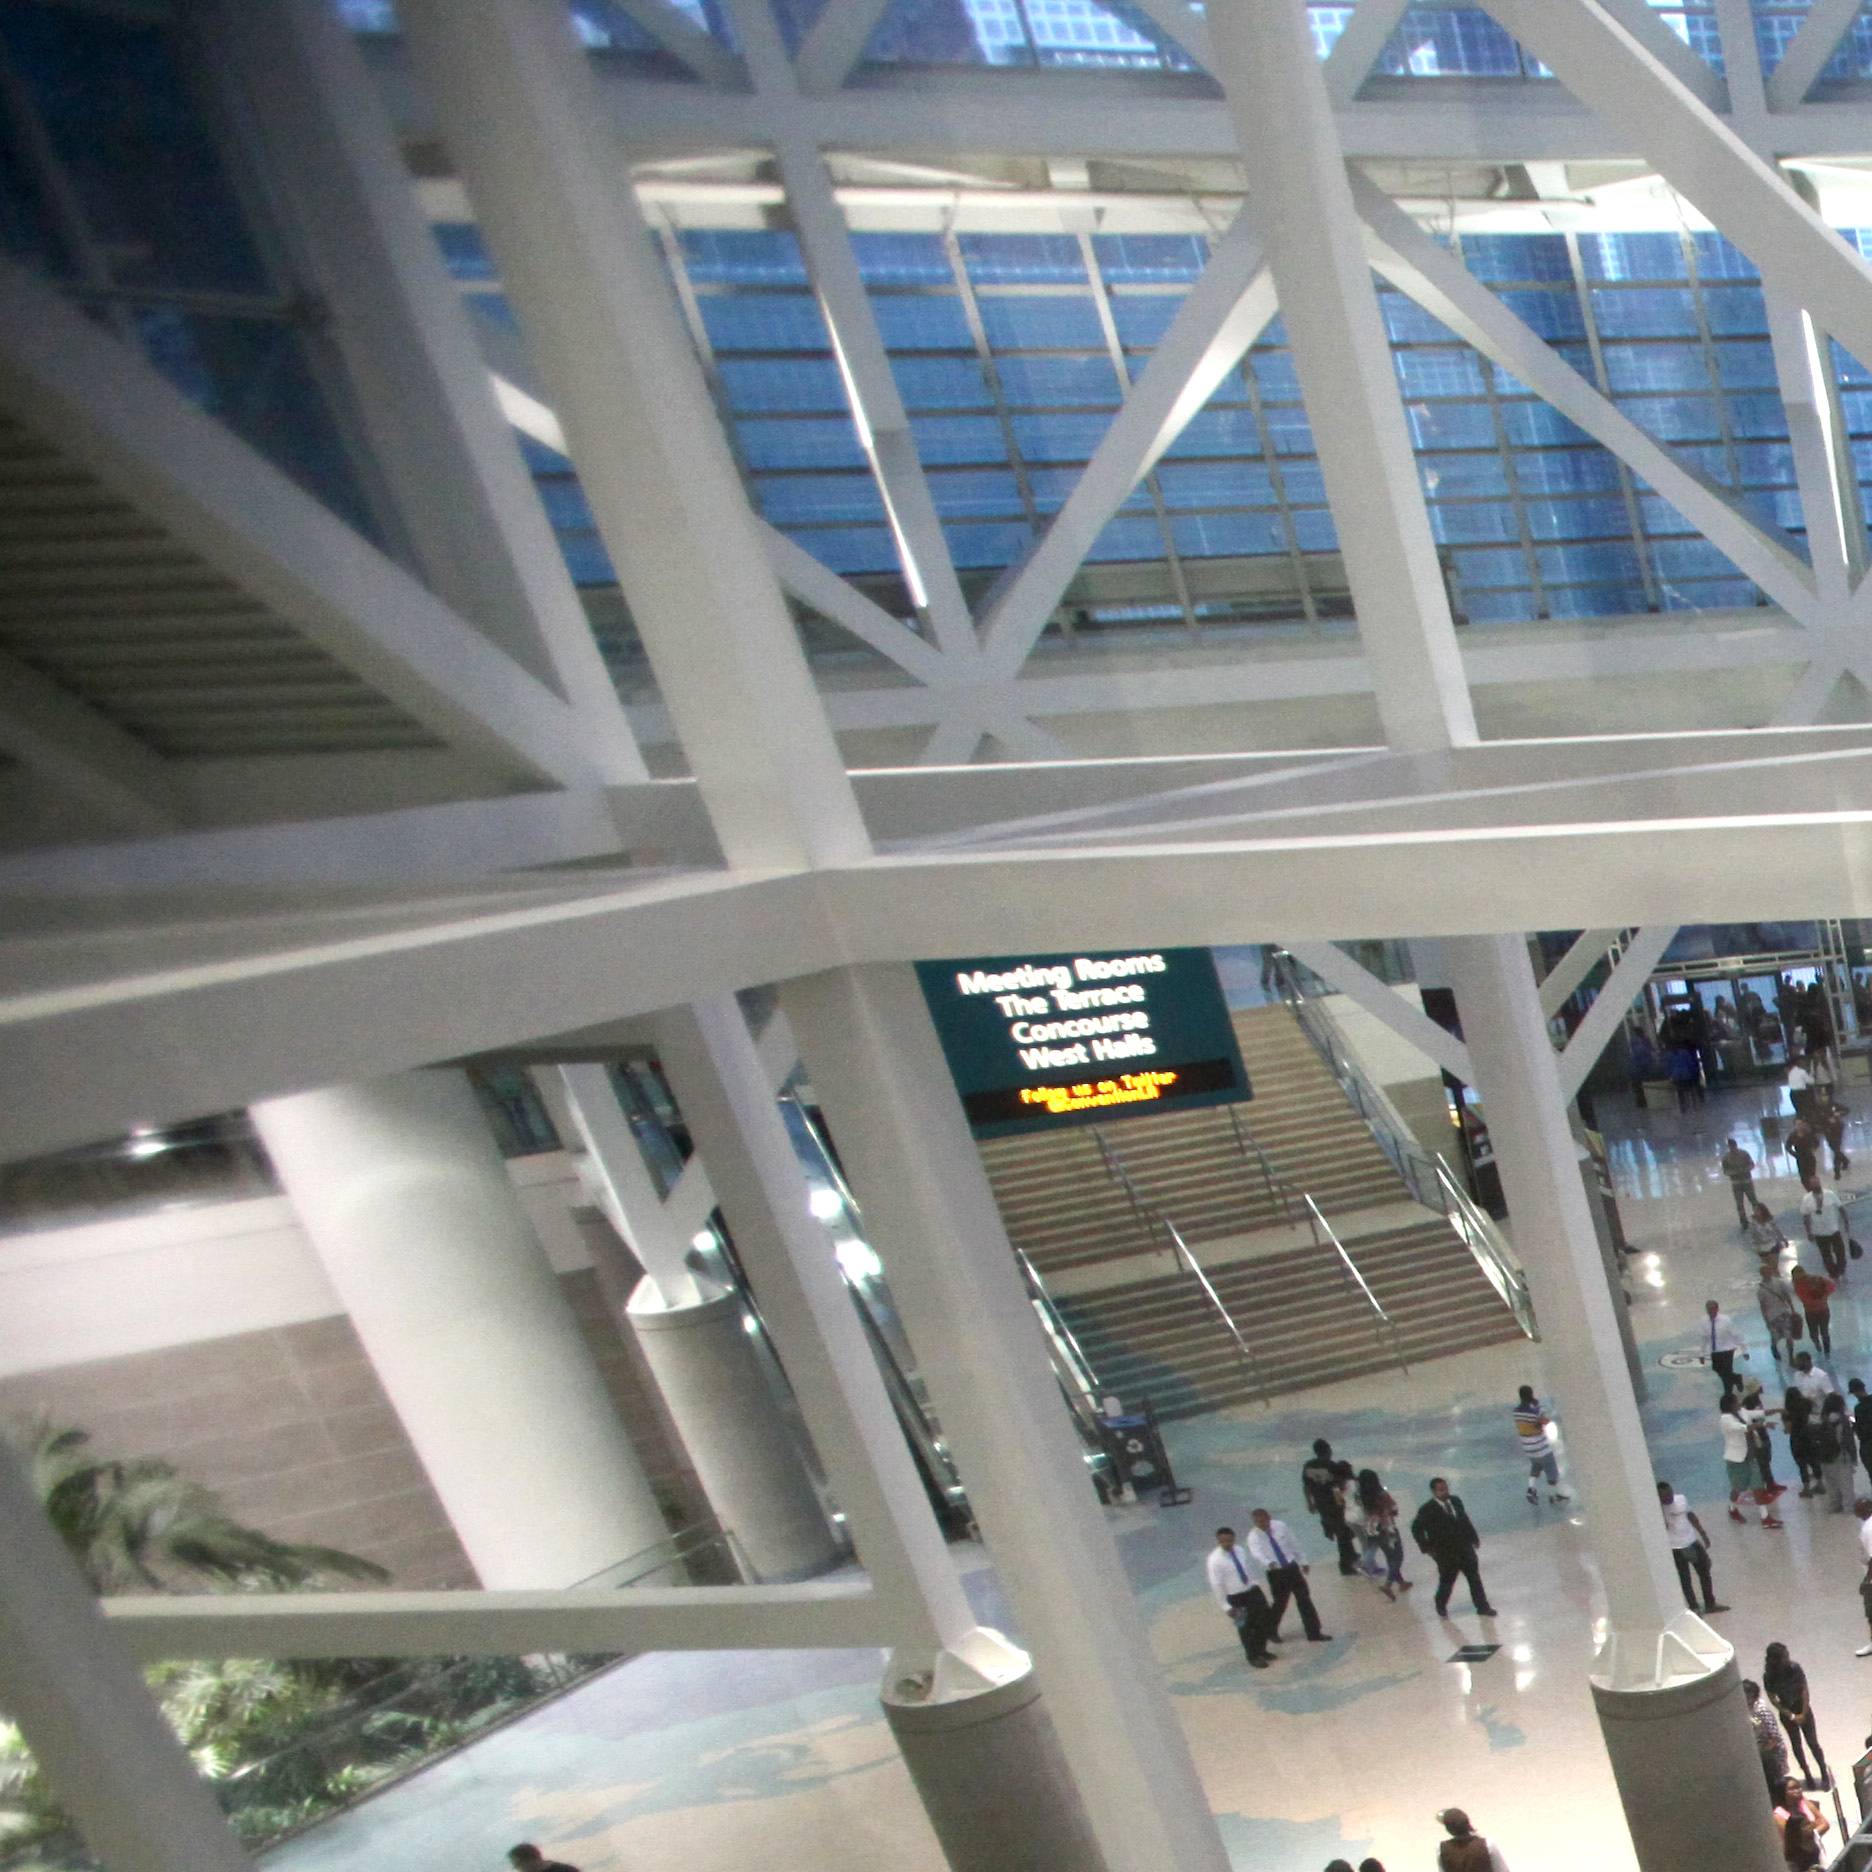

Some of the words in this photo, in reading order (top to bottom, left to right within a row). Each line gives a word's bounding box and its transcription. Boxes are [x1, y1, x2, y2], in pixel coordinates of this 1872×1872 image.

[957, 963, 1074, 994] Meeting
[1075, 953, 1166, 982] Rooms
[996, 996, 1048, 1018] The
[1050, 982, 1145, 1012] Terrace
[1011, 1010, 1149, 1044] Concourse
[1019, 1044, 1090, 1070] West
[1091, 1033, 1156, 1061] Halls
